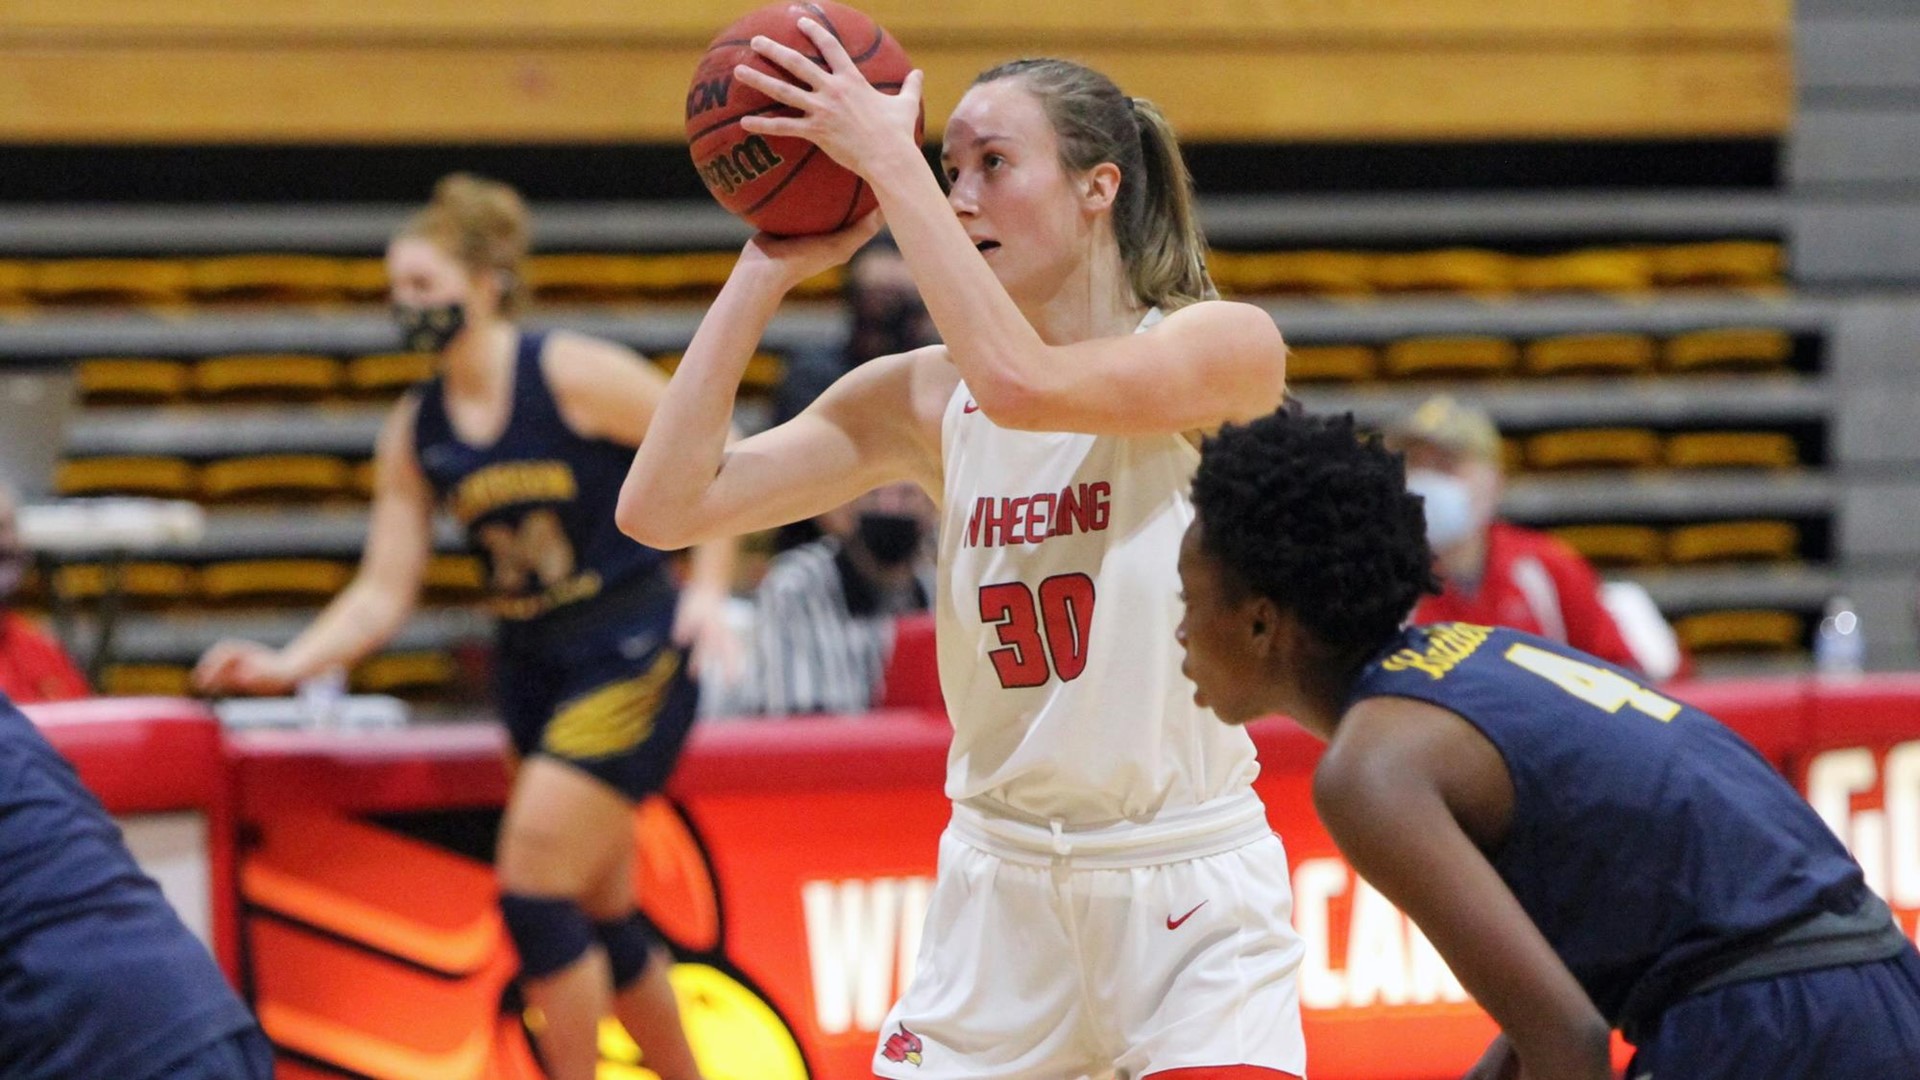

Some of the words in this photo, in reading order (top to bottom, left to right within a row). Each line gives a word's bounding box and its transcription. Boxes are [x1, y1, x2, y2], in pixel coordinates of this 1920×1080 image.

[964, 481, 1111, 549] WHEELING
[978, 572, 1096, 689] 30
[1504, 642, 1682, 722] 4
